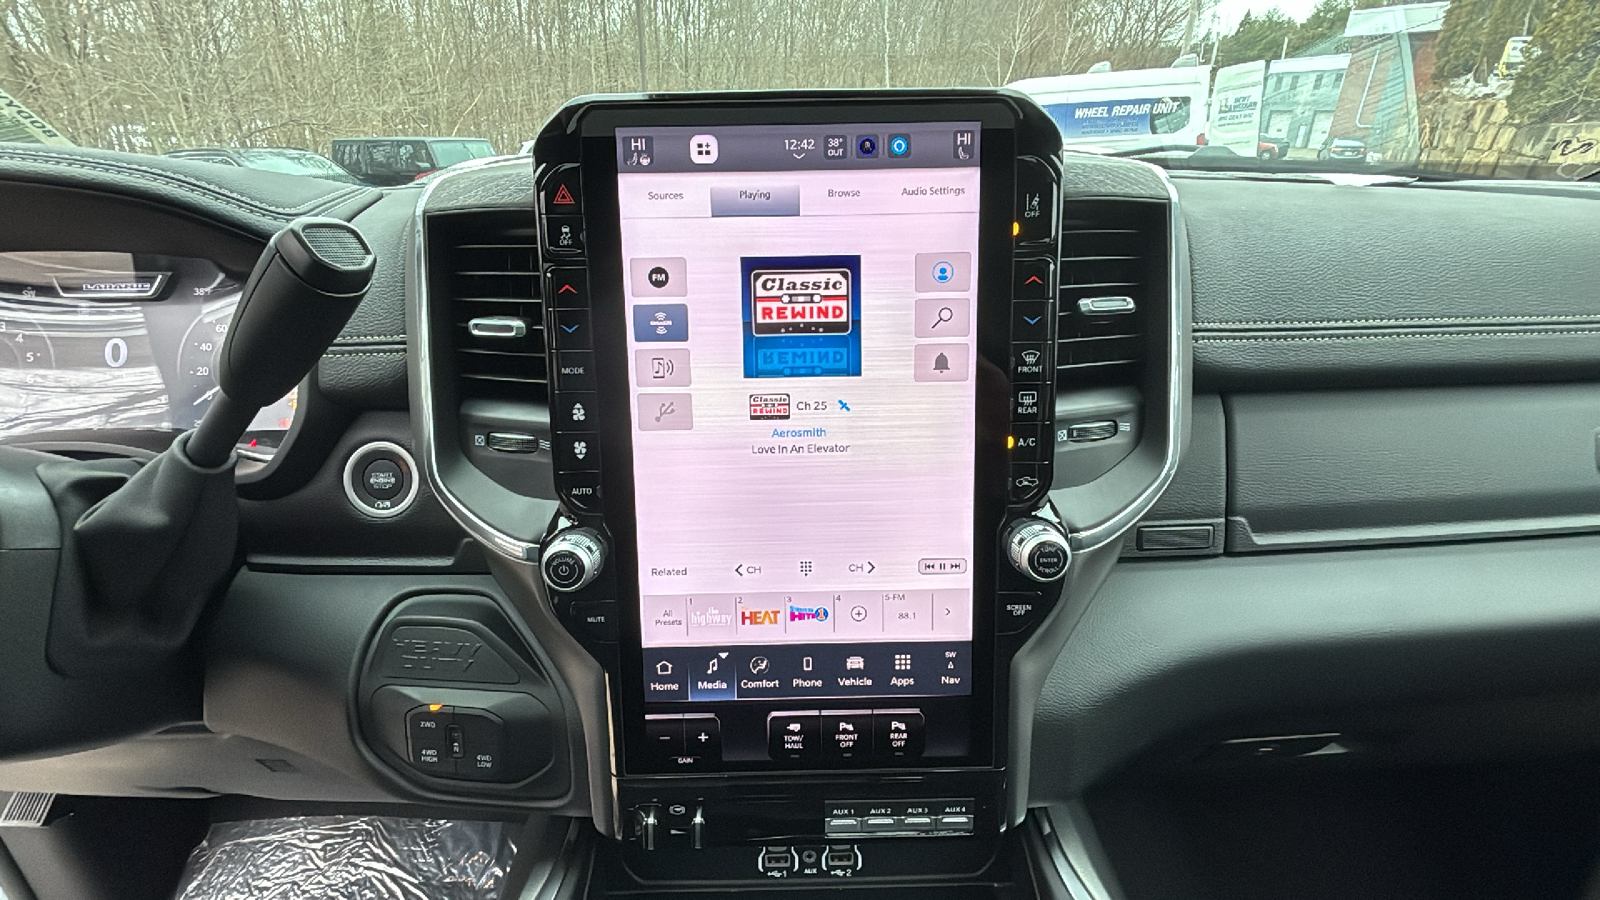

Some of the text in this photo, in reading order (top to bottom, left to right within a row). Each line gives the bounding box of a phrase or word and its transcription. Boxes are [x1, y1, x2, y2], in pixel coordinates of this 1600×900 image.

[1075, 101, 1181, 119] WHEEL REPAIR UNIT
[828, 138, 843, 147] 38°
[957, 133, 971, 145] HI
[631, 138, 646, 151] HI
[784, 139, 815, 150] 12:42
[648, 191, 684, 200] Sources
[739, 190, 771, 202] Playing
[828, 188, 861, 198] Browse
[902, 186, 965, 198] Audio Settings
[652, 273, 667, 282] FM
[761, 277, 843, 292] Classic
[761, 305, 844, 320] REWIND
[216, 324, 228, 333] 60
[15, 333, 24, 343] 4
[200, 343, 212, 351] 40
[26, 352, 34, 362] 5
[104, 338, 128, 367] 0
[197, 367, 209, 376] 20
[561, 367, 585, 375] MODE
[796, 401, 827, 410] Ch 25
[1018, 406, 1037, 414] REAR
[771, 427, 827, 438] Aerosmith
[1018, 437, 1036, 447] A/C
[752, 443, 850, 454] Love In An Elevator
[552, 556, 576, 566] VOLUME
[652, 567, 687, 577] Related
[746, 565, 762, 574] CH
[848, 563, 864, 572] CH
[691, 612, 732, 627] highway
[741, 610, 780, 626] HEAT
[898, 612, 916, 620] 88.1
[698, 681, 728, 690] Media
[741, 678, 779, 689] Comfort
[793, 678, 822, 687] Phone
[838, 676, 872, 686] Vehicle
[890, 676, 914, 688] Apps
[941, 676, 960, 685] Nav
[650, 682, 679, 691] Home
[846, 869, 852, 877] 2
